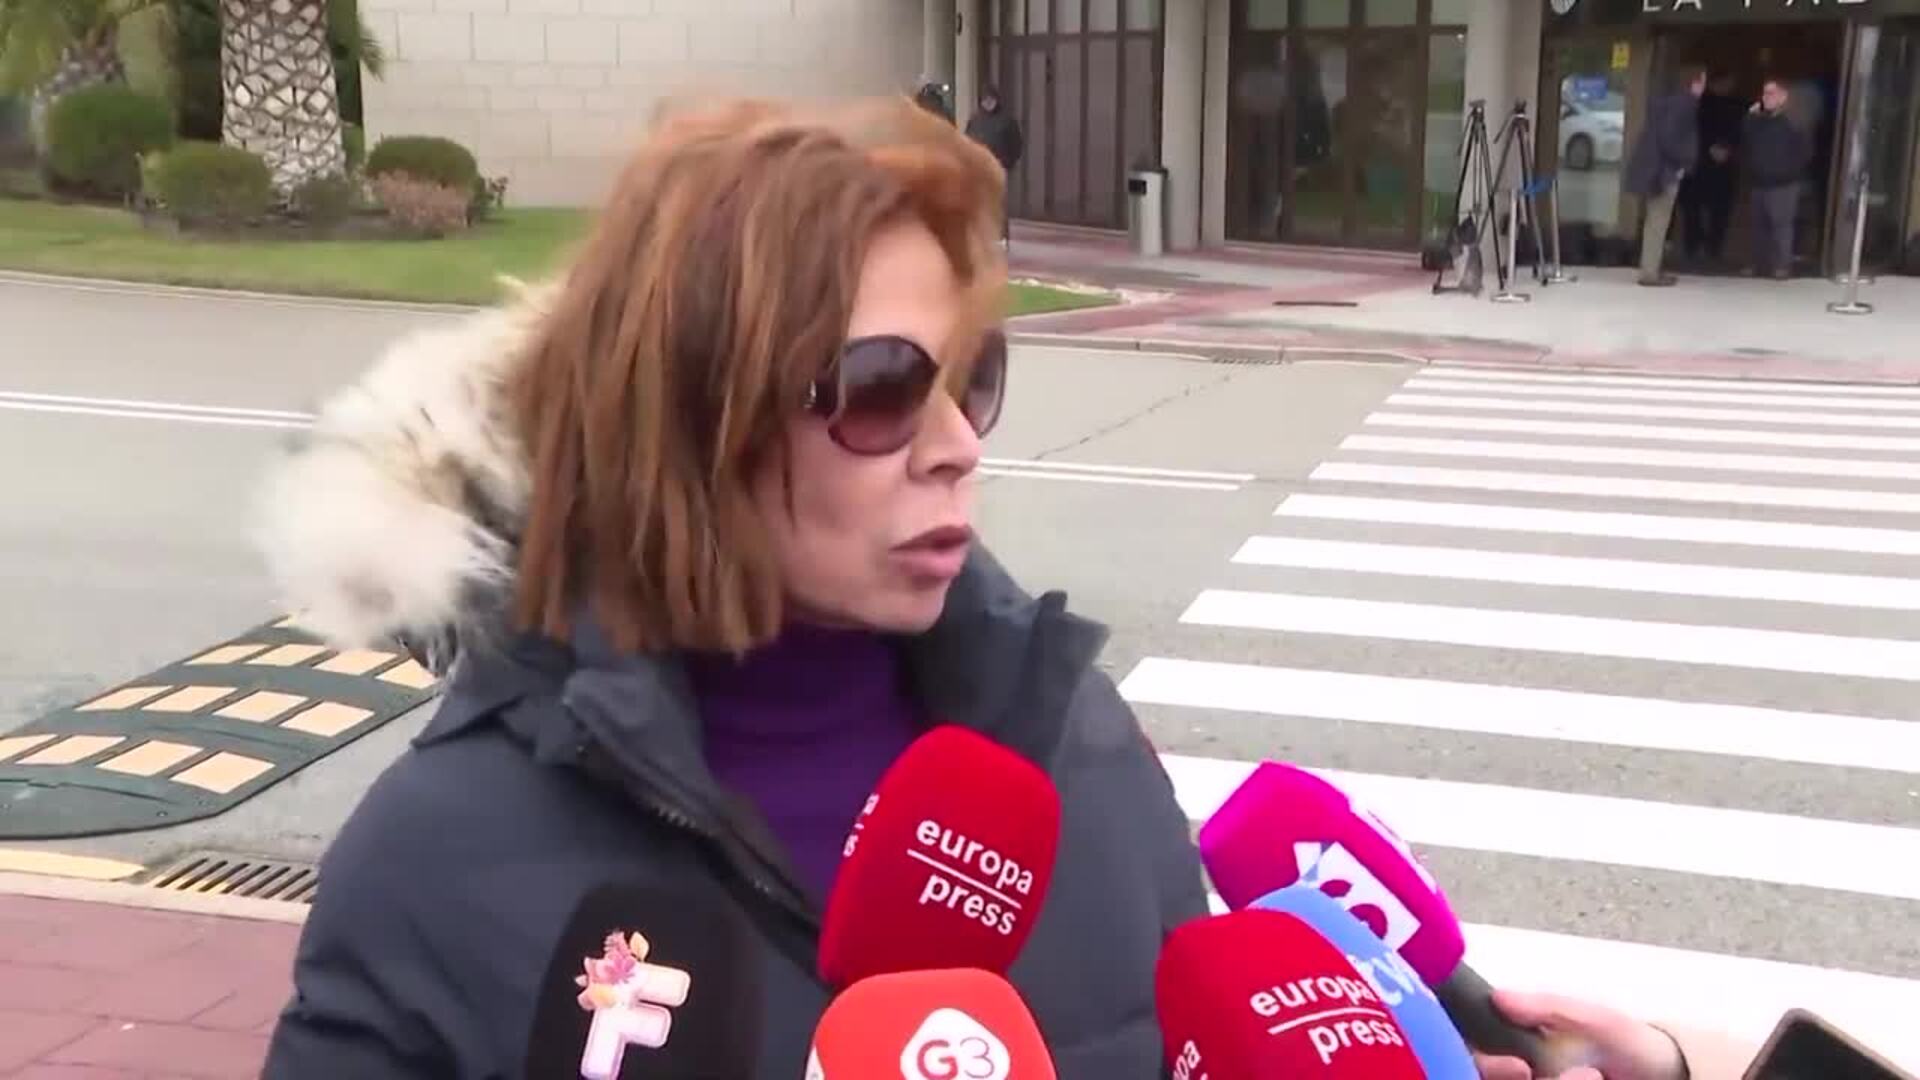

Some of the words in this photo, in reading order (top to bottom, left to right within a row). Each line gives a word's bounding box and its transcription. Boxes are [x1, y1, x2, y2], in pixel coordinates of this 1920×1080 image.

[916, 818, 1033, 896] europa
[918, 874, 1017, 935] press
[579, 957, 691, 1080] F
[1249, 974, 1379, 1017] europa
[916, 1036, 995, 1080] G3
[1307, 1019, 1405, 1065] press
